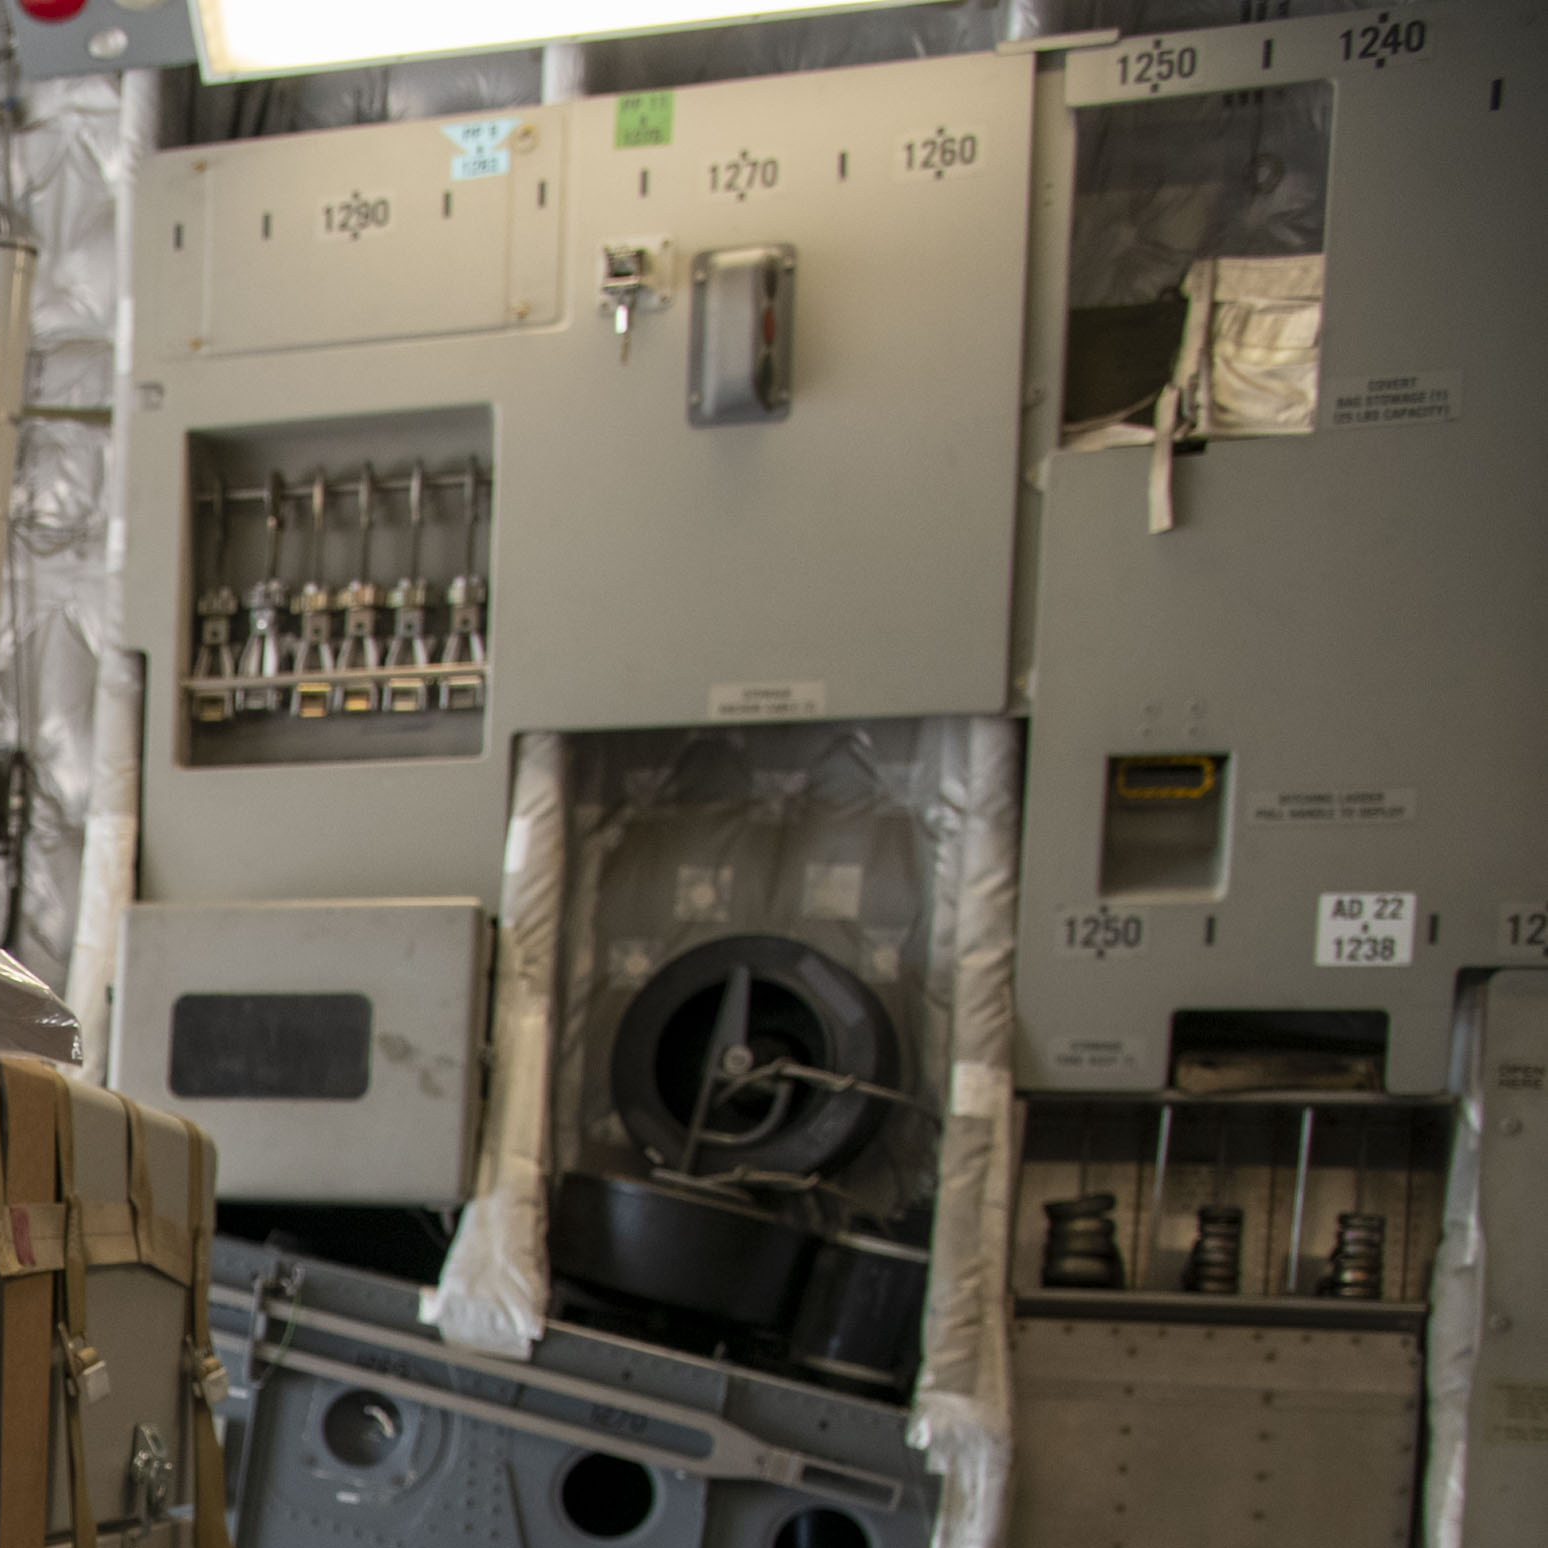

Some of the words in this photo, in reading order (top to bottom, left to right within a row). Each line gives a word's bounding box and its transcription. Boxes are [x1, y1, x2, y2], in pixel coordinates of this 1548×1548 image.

[1340, 20, 1427, 61] 1240
[1116, 48, 1198, 85] 1250
[903, 135, 977, 171] 1260
[708, 159, 779, 193] 1270
[323, 199, 391, 231] 1290
[1331, 899, 1365, 921] AD
[1374, 897, 1404, 920] 22
[1064, 914, 1143, 947] 1250
[1507, 914, 1548, 946] 12
[1332, 937, 1397, 962] 1238
